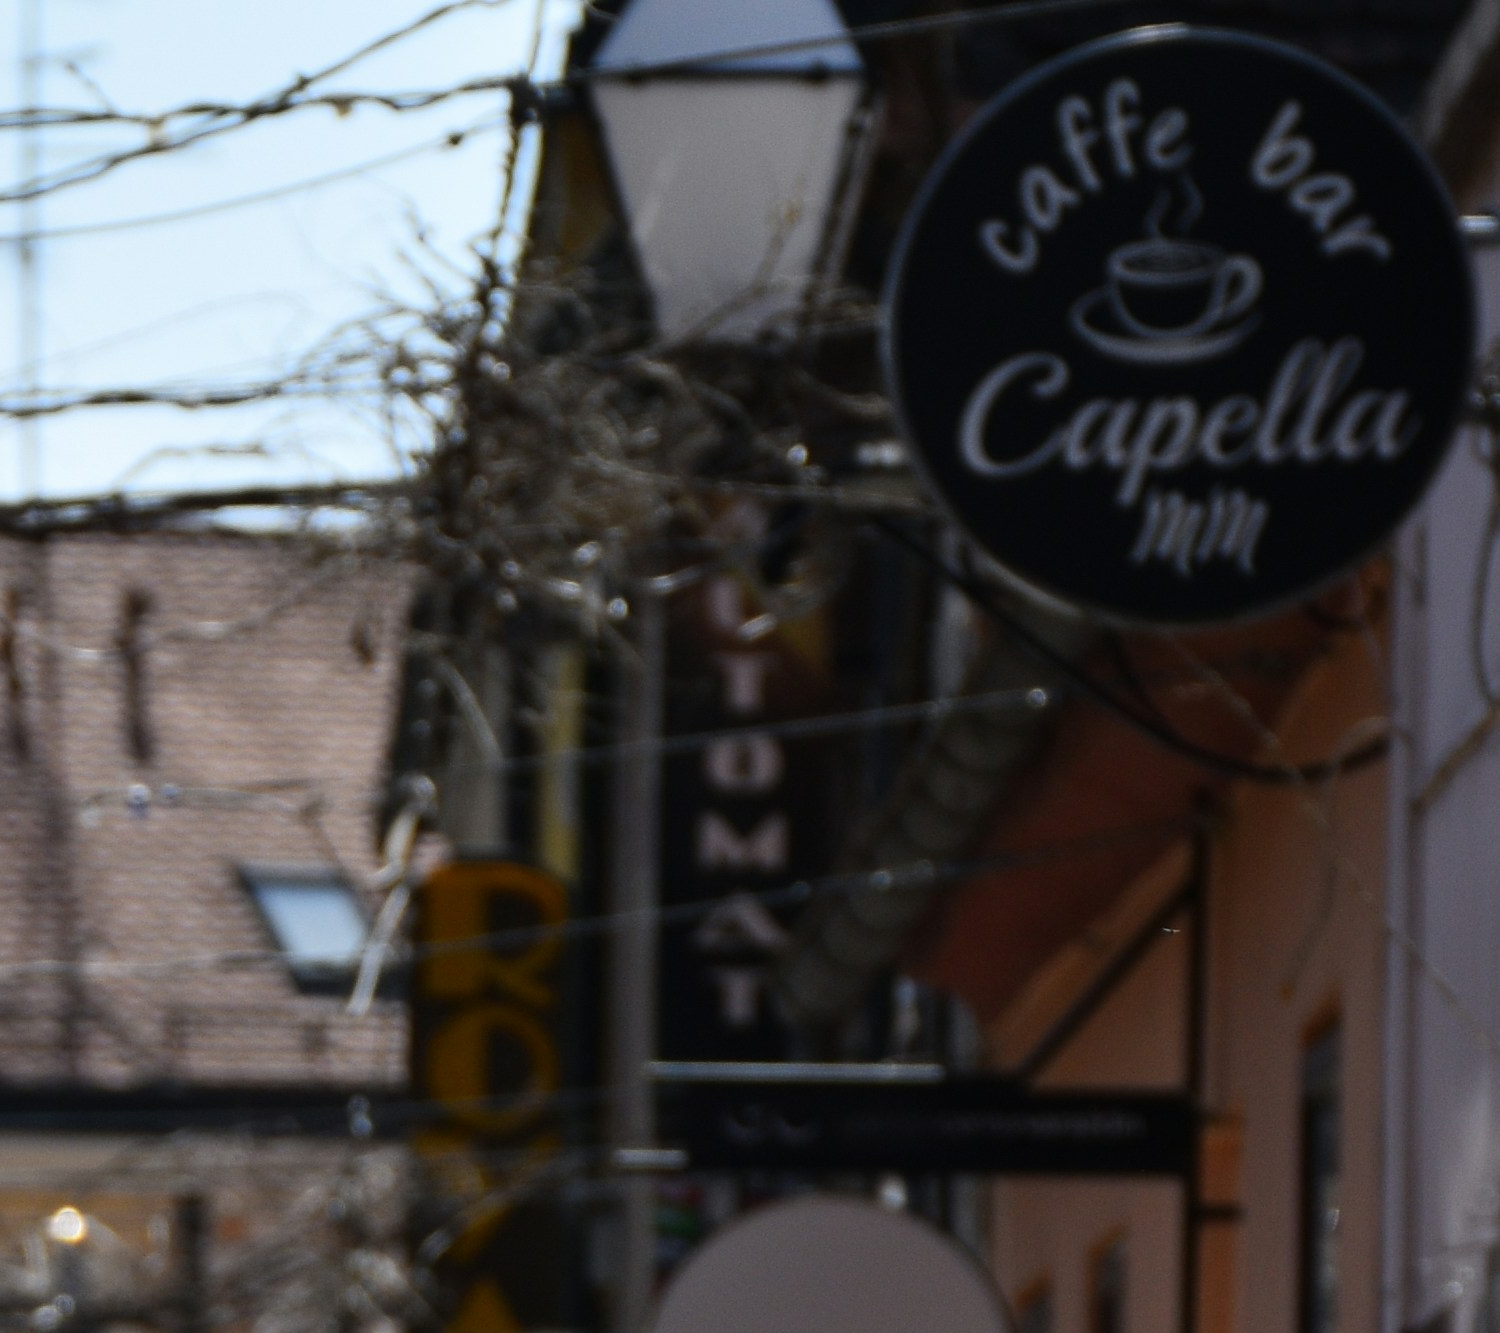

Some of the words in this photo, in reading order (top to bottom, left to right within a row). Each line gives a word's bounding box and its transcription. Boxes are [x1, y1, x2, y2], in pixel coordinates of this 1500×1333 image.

[979, 77, 1194, 274] caffe
[1250, 101, 1392, 262] bar
[959, 337, 1417, 504] Capella
